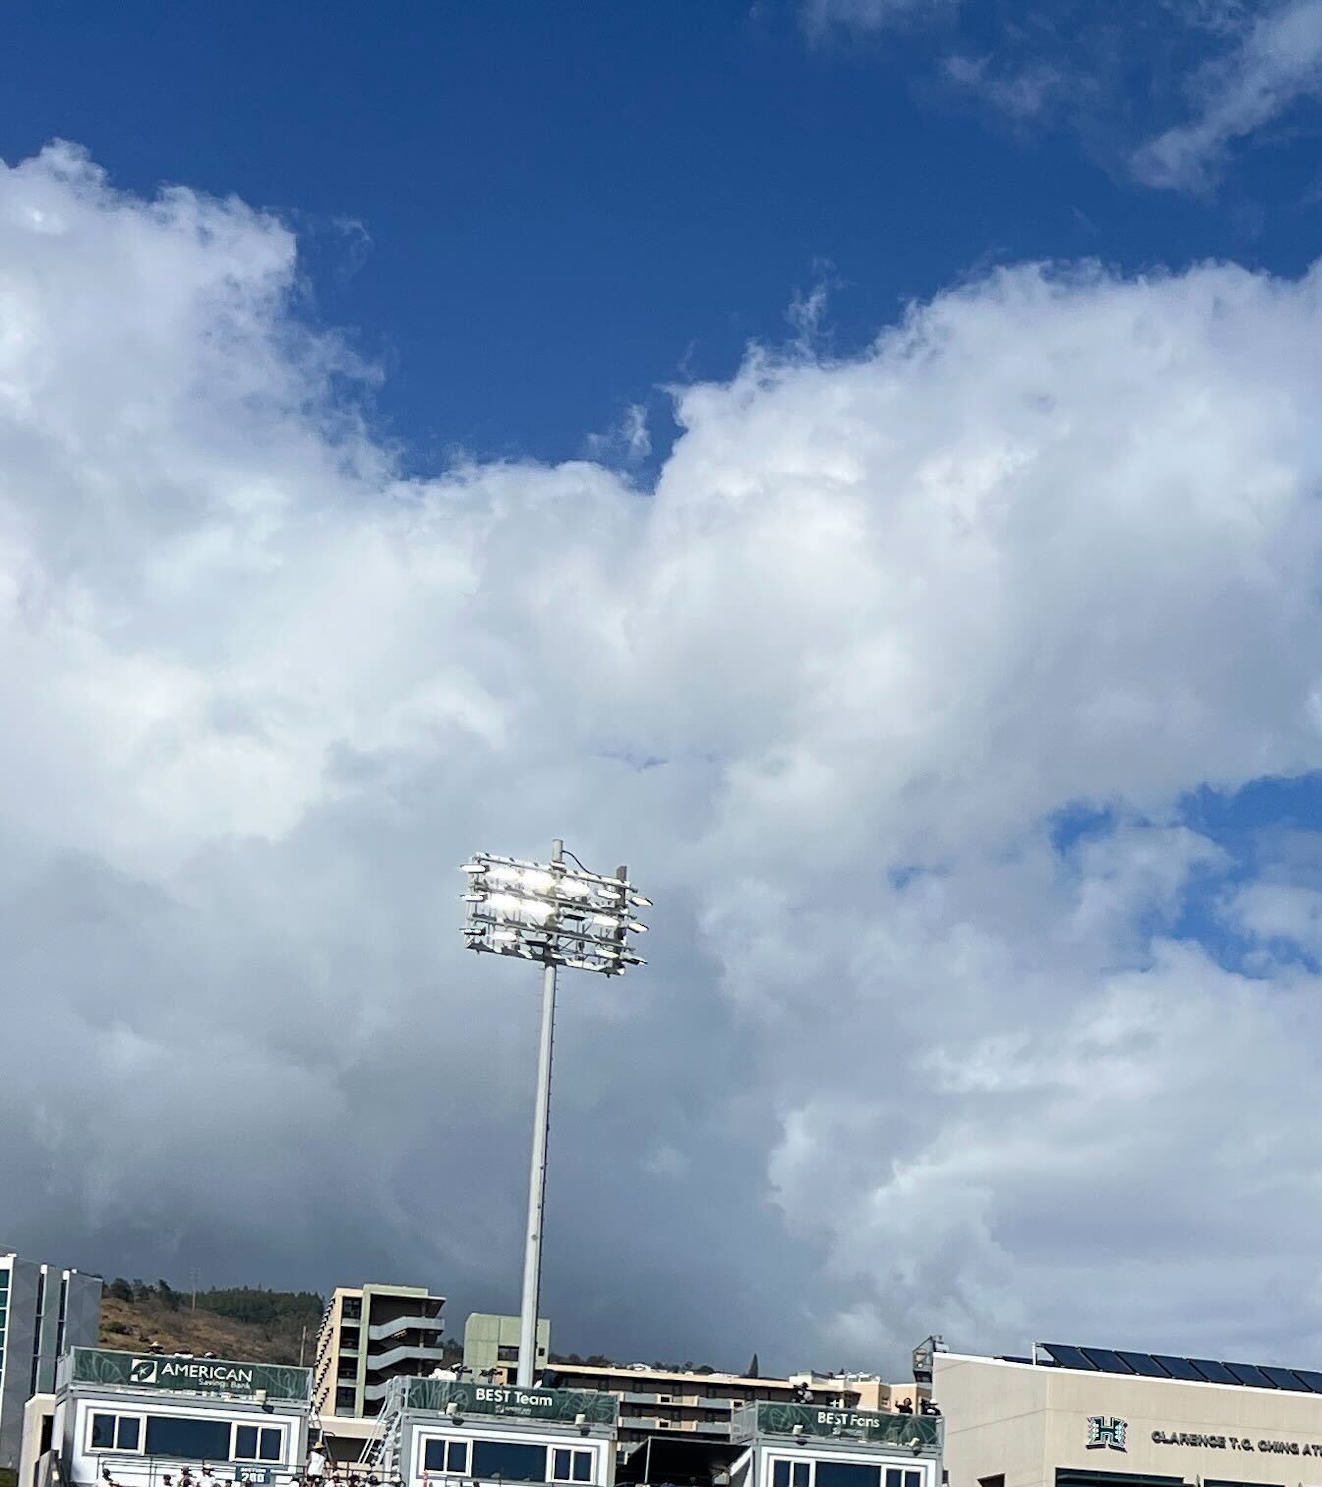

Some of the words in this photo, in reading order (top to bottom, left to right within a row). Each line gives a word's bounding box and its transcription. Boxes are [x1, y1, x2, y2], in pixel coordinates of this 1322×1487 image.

[161, 1363, 253, 1382] AMERICAN
[230, 1381, 251, 1389] Bank
[476, 1388, 511, 1403] BEST
[514, 1391, 553, 1406] Team
[818, 1412, 848, 1425] BEST
[850, 1414, 880, 1428] Fans
[1151, 1431, 1227, 1449] CLARENCE
[1258, 1439, 1299, 1455] CHING
